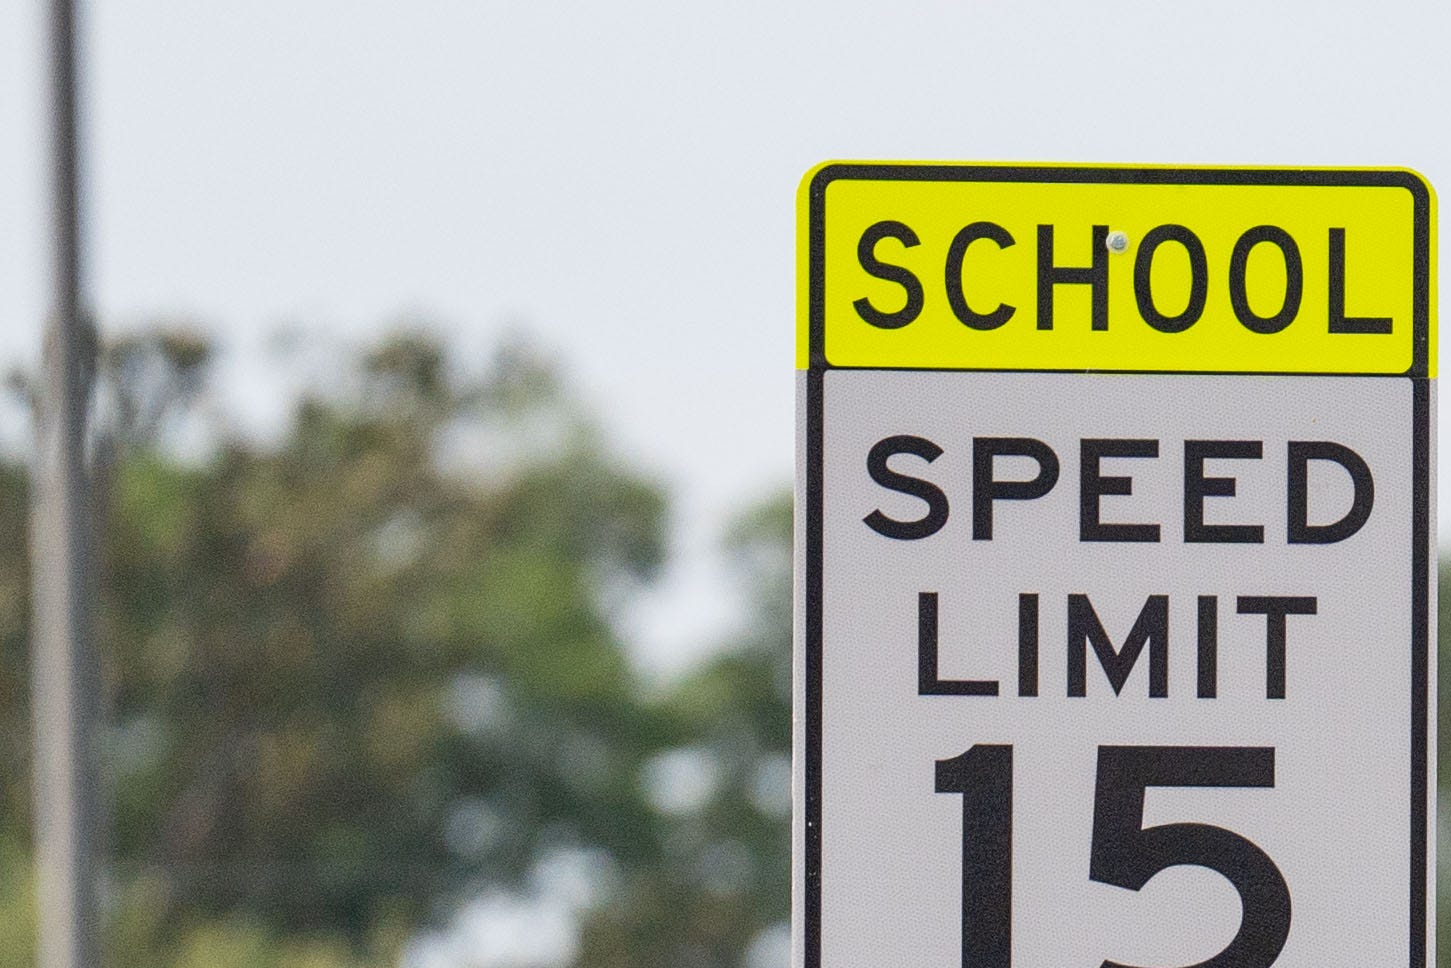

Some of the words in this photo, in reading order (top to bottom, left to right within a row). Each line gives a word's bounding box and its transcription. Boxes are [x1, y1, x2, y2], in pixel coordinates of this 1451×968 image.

[851, 219, 1394, 335] SCHOOL
[861, 434, 1376, 545] SPEED
[917, 591, 1319, 701] LIMIT
